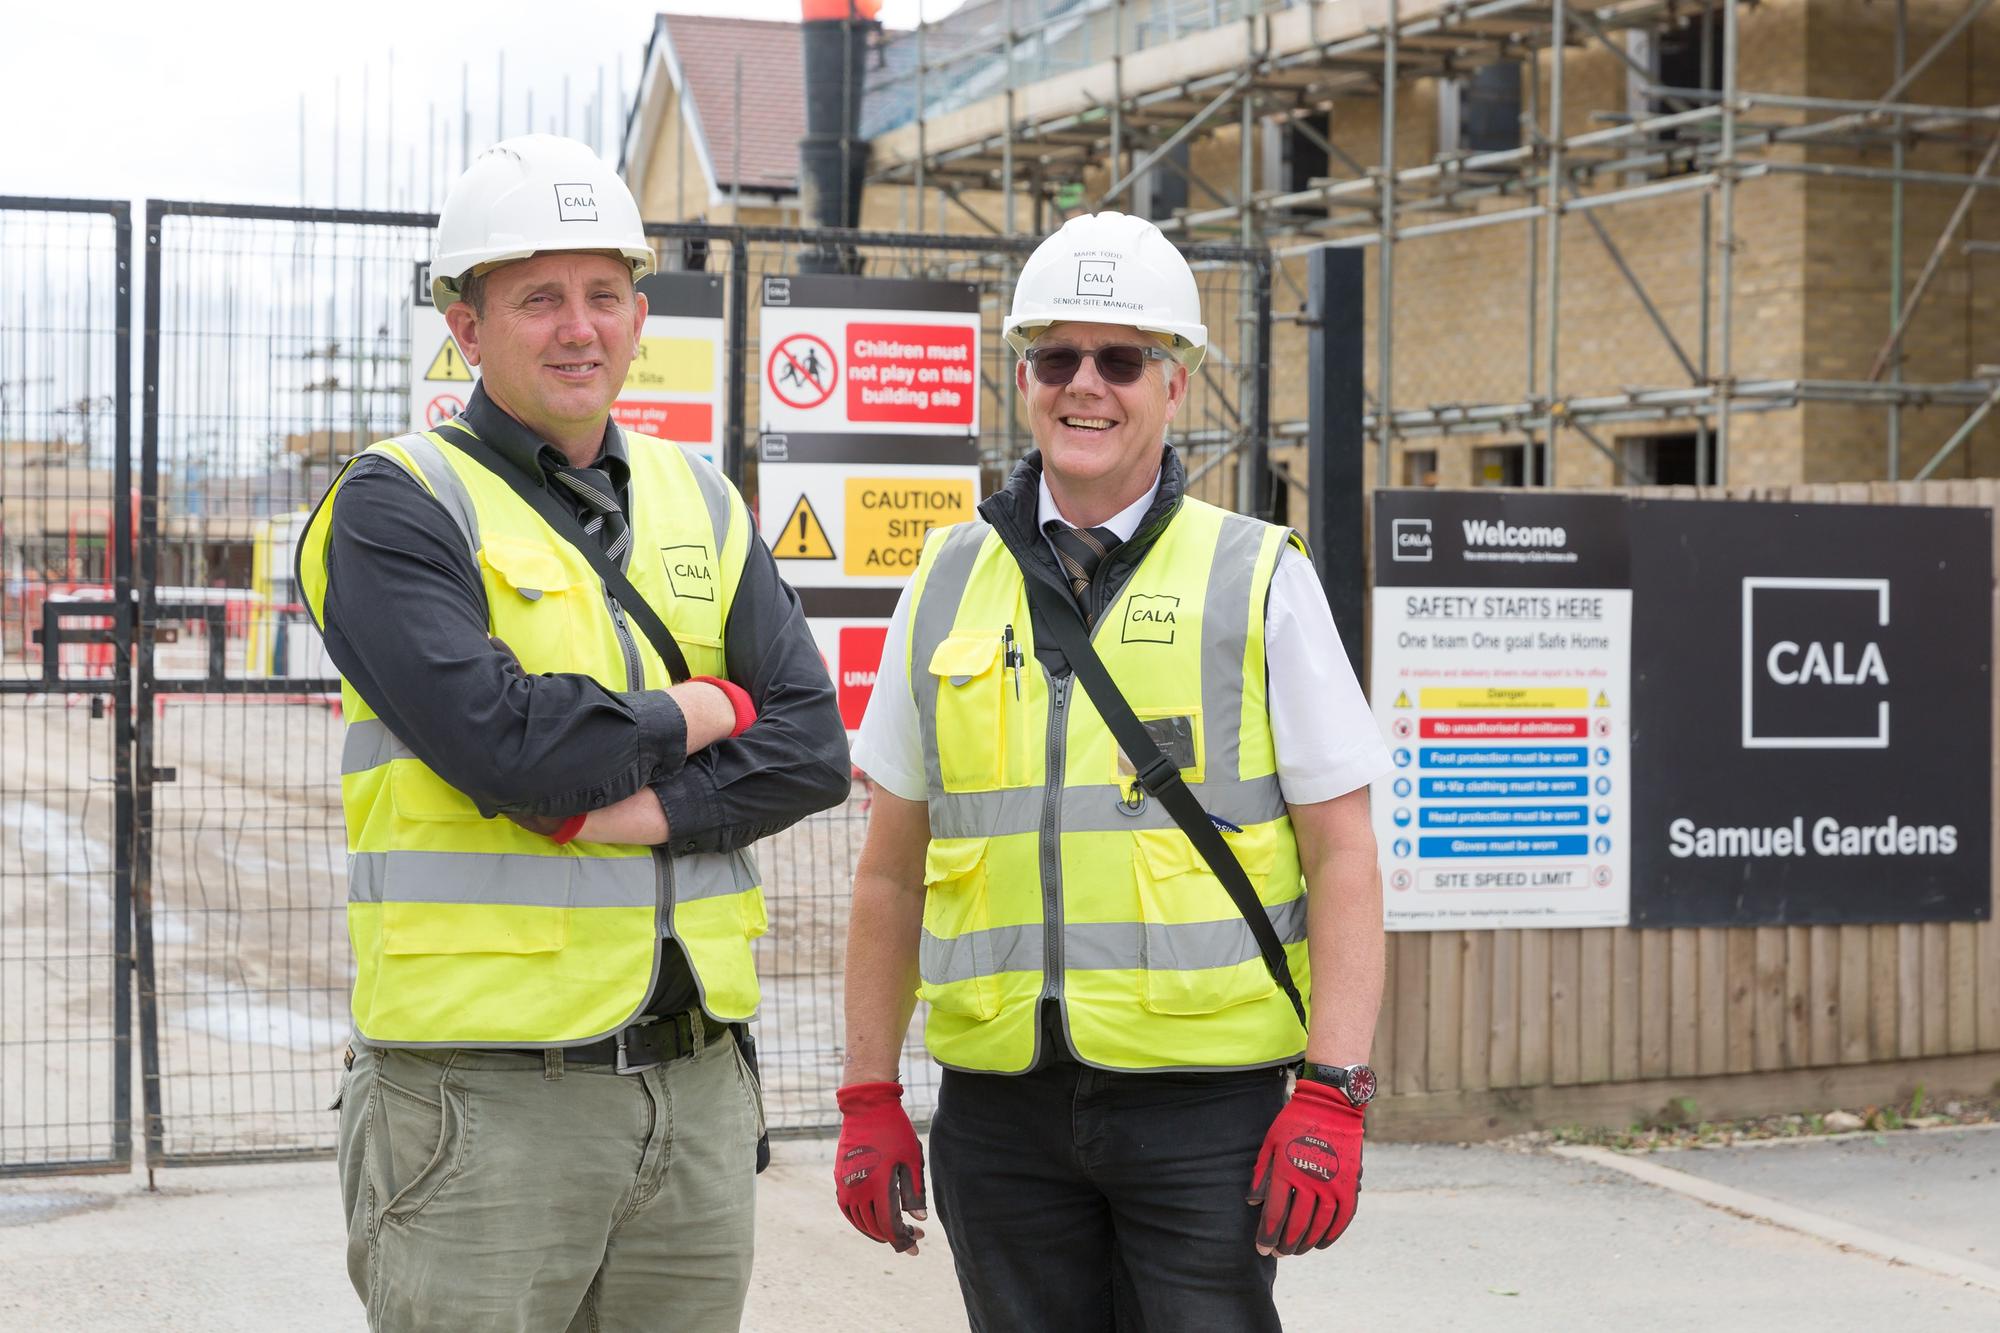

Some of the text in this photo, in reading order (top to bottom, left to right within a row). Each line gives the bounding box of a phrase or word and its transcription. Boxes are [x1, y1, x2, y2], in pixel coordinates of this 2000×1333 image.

[564, 197, 596, 207] CALA
[1073, 250, 1123, 260] MARK TODD
[1083, 273, 1114, 284] CALA
[1053, 297, 1144, 311] SENIOR SITE MANAGER
[854, 339, 968, 361] Children must
[639, 371, 665, 384] Site
[849, 364, 973, 385] not play on this
[862, 386, 961, 409] building site
[642, 408, 667, 422] play
[861, 490, 963, 509] CAUTION
[1398, 519, 1567, 548] CALA Welcome
[674, 564, 712, 580] CALA
[1407, 596, 1603, 618] SAFETY STARTS HERE
[1131, 609, 1176, 624] CALA
[1398, 632, 1609, 653] One team One goal Safe Home
[1766, 640, 1889, 685] CALA
[1487, 688, 1526, 700] Danger
[1434, 722, 1575, 734] No unauthorised admittance
[1431, 750, 1579, 765] Foot protection must be worn
[1466, 780, 1508, 795] clothing
[1510, 780, 1535, 791] must
[1536, 779, 1549, 791] be
[1551, 781, 1576, 791] worn
[1428, 809, 1580, 825] Head protection must be worn
[1668, 814, 1959, 858] Samuel Gardens
[1451, 839, 1558, 852] Gloves must be worn
[1434, 871, 1573, 888] SITE SPEED LIMIT
